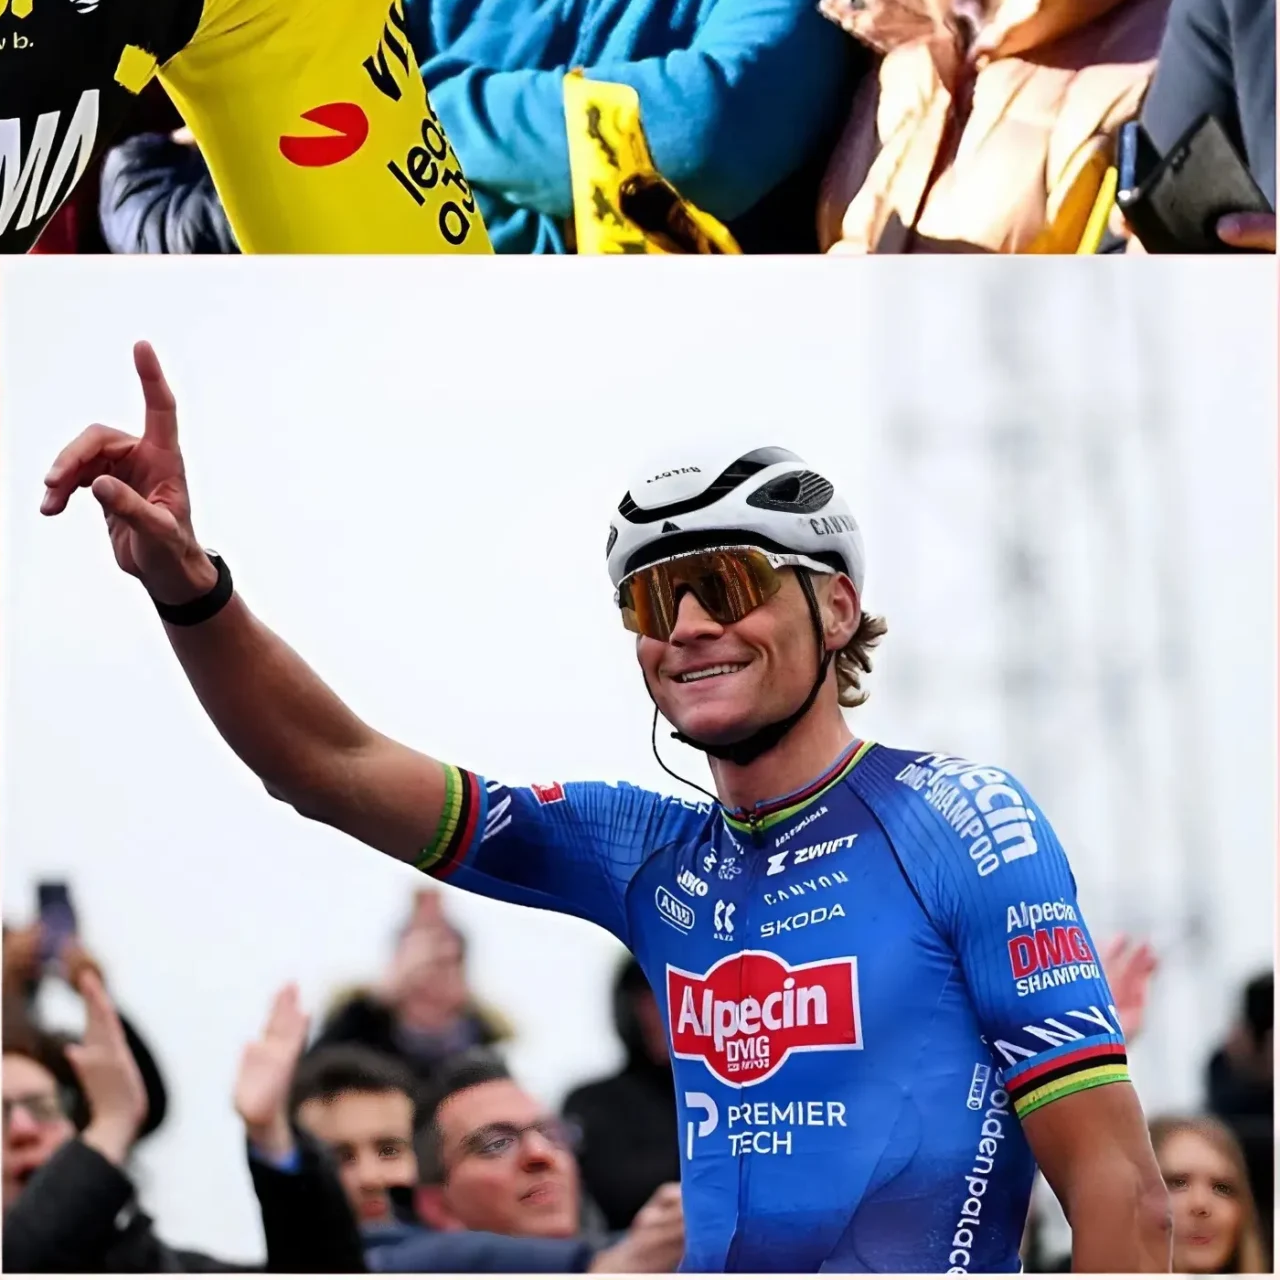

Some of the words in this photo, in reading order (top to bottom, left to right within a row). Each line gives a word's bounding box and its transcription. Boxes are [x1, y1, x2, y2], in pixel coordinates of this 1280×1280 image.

[793, 833, 859, 865] ZWIFT
[763, 870, 850, 906] CANYON
[1006, 898, 1076, 933] Alpecin
[1007, 925, 1095, 981] DMG
[1016, 963, 1101, 997] SHAMPOO
[677, 977, 828, 1053] Alpecin
[726, 1035, 770, 1062] DMG
[727, 1101, 847, 1129] PREMIER
[728, 1130, 793, 1157] TECH
